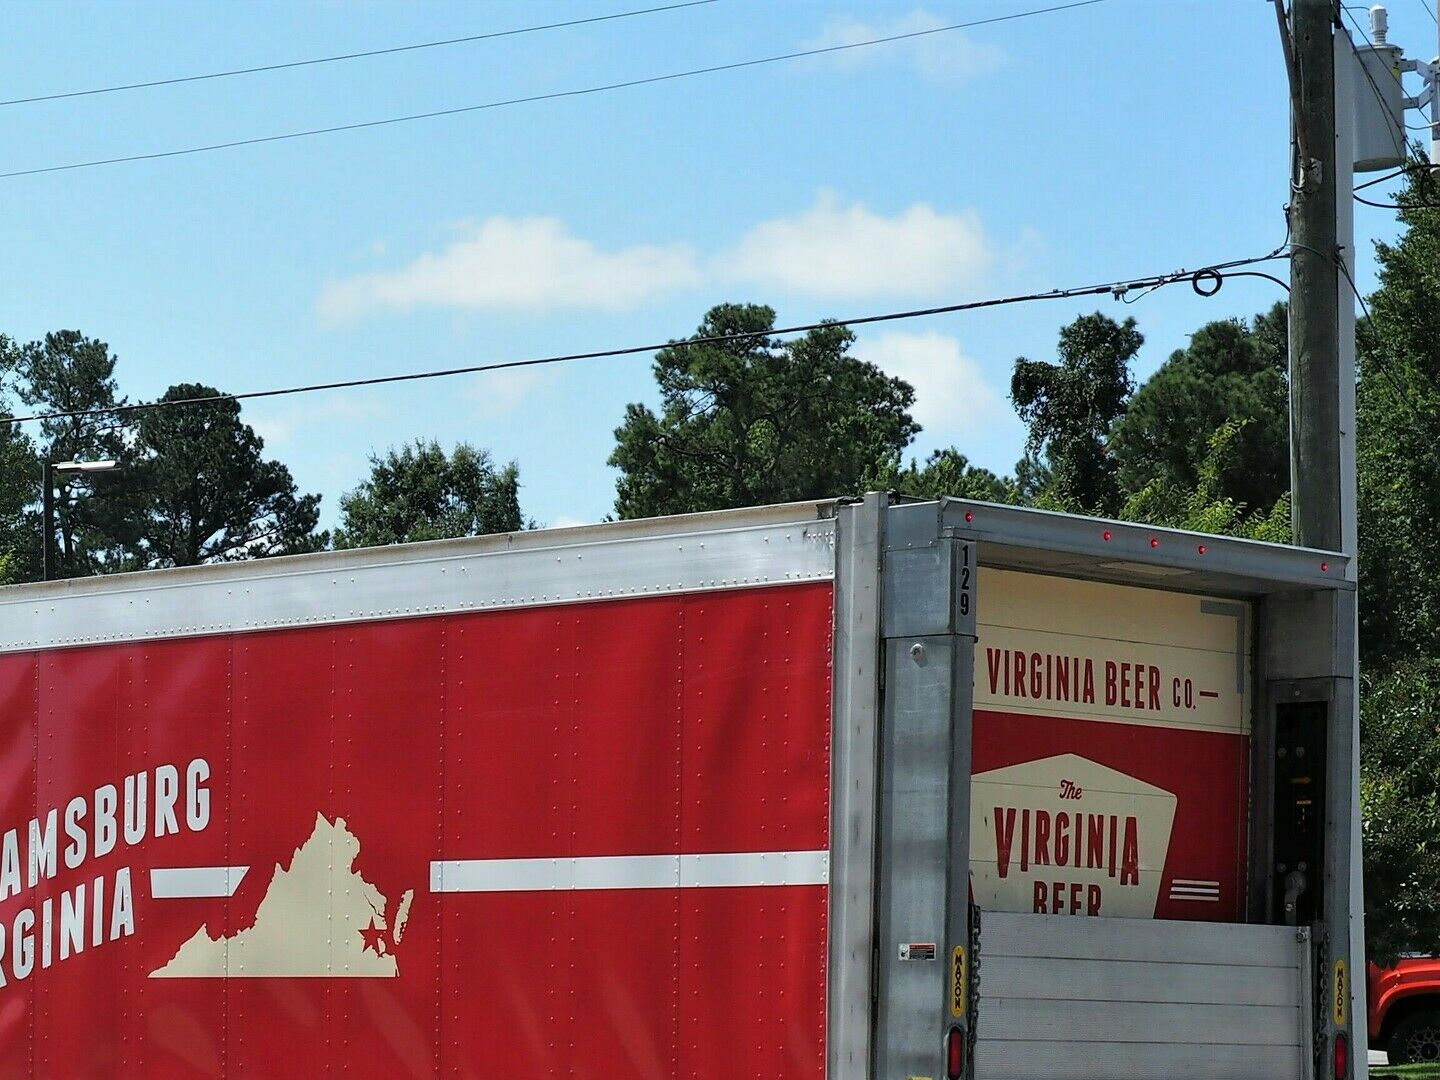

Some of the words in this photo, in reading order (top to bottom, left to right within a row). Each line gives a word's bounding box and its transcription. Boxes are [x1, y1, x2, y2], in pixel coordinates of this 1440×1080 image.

[960, 545, 970, 616] 129
[986, 648, 1095, 704] VIRGINIA
[1105, 661, 1162, 711] BEER
[1059, 779, 1083, 800] The
[994, 807, 1140, 886] VIRGINIA
[1033, 880, 1102, 917] BEER
